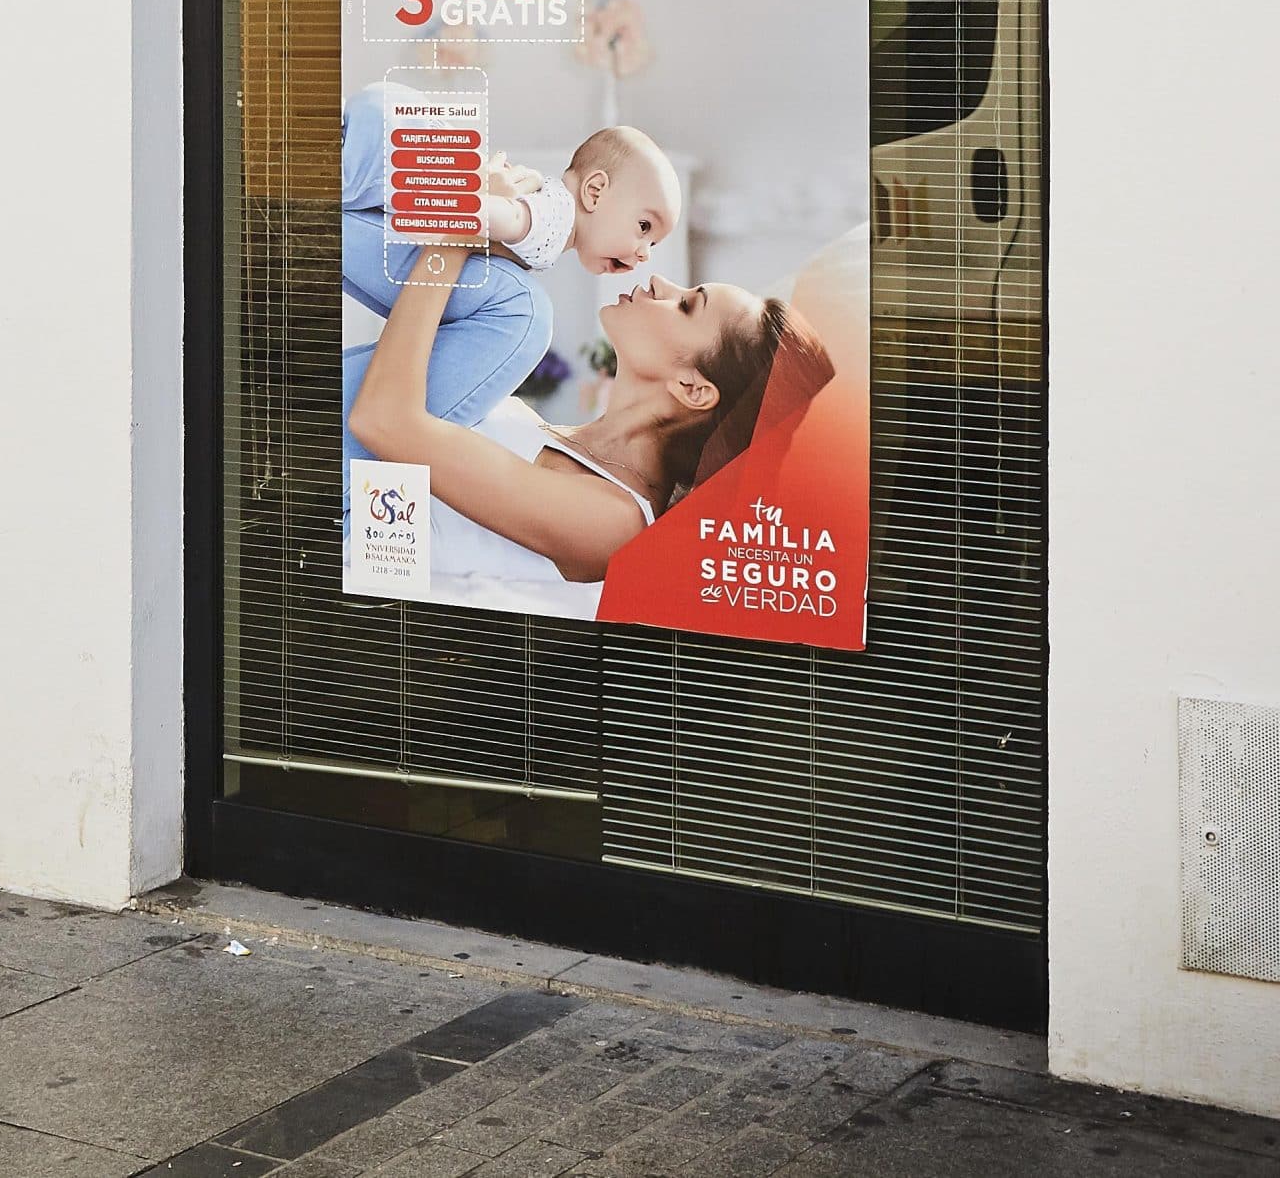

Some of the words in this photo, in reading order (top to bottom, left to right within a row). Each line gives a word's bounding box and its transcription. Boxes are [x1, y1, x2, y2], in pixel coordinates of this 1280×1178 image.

[395, 106, 445, 117] MAPFRE
[448, 107, 477, 117] Salud
[401, 134, 431, 145] TARJETA
[431, 135, 471, 144] SANITARIA
[416, 155, 455, 165] BUSCADOR
[405, 177, 467, 187] AUTORIZACIONES
[414, 198, 430, 207] CITA
[431, 198, 458, 208] ONLINE
[395, 218, 438, 228] REEMBOLSO
[438, 219, 448, 229] DE
[449, 220, 478, 230] GASTOS
[749, 496, 783, 527] tu
[700, 518, 836, 552] FAMILIA
[728, 547, 790, 563] NECESITA
[793, 553, 813, 565] UN
[700, 558, 837, 592] SEGURO
[700, 584, 722, 598] de
[724, 584, 837, 617] VERDAD
